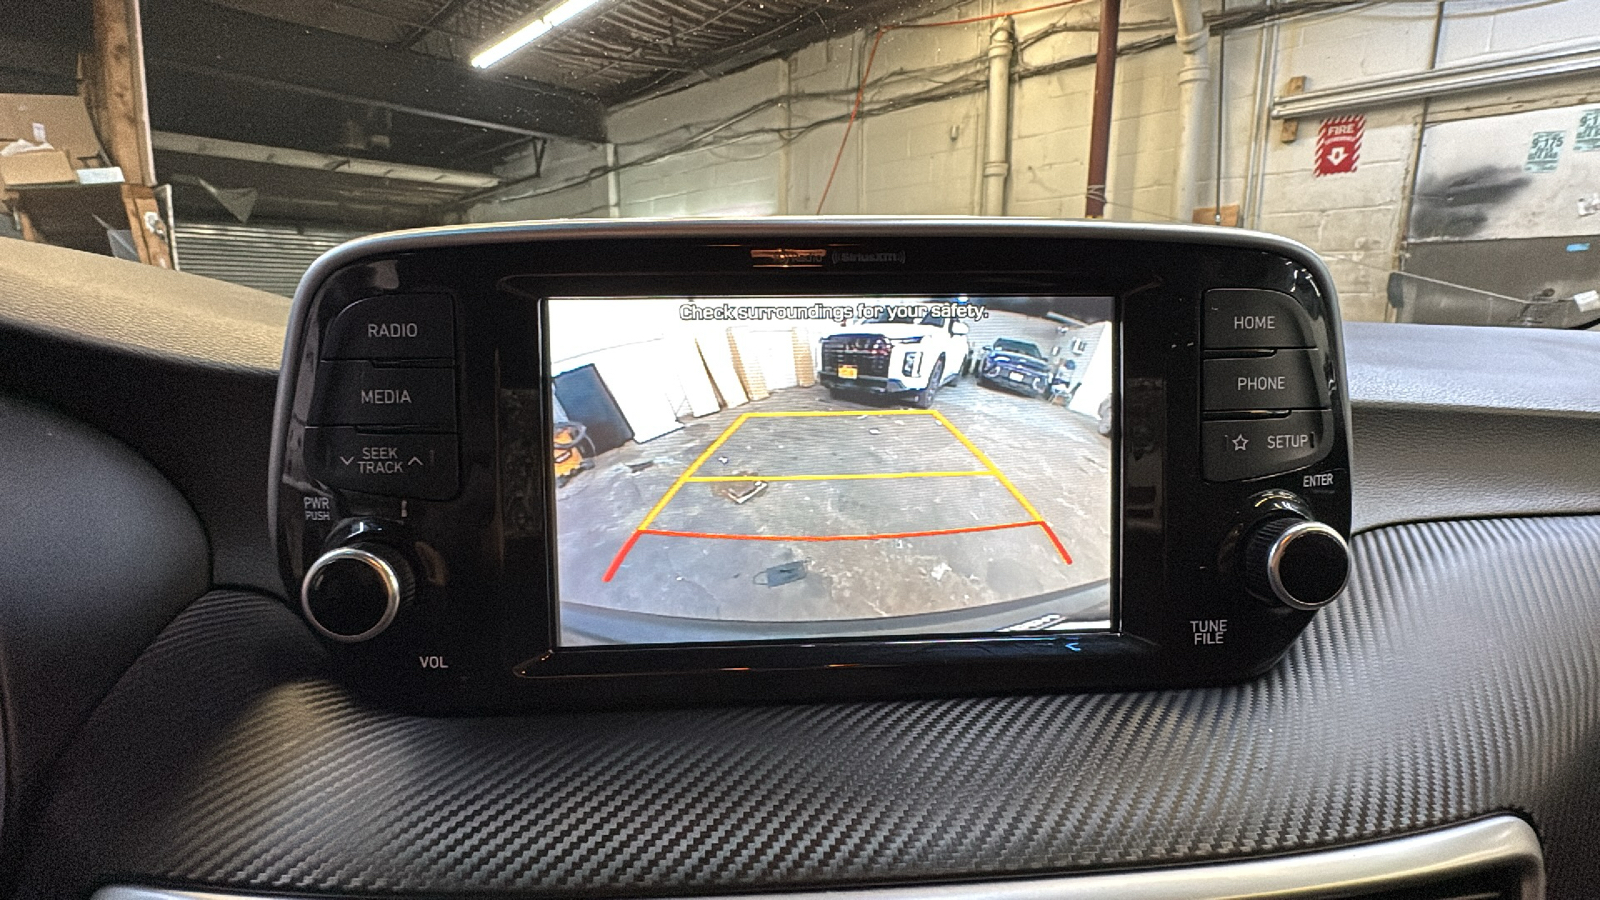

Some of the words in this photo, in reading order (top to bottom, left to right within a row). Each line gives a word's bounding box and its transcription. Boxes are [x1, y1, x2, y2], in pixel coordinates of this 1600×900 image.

[1327, 123, 1355, 136] FIRE
[679, 303, 737, 321] Check
[736, 303, 853, 323] surroundings
[857, 303, 884, 319] for
[885, 304, 927, 321] your
[931, 302, 989, 322] safety.
[1233, 315, 1276, 330] HOME
[367, 322, 418, 339] RADIO
[1237, 376, 1286, 391] PHONE
[360, 389, 412, 405] MEDIA
[1266, 434, 1309, 450] SETUP
[361, 447, 399, 461] SEEK
[357, 460, 404, 475] TRACK
[1302, 473, 1334, 488] ENTER
[303, 496, 331, 510] PWR
[304, 510, 331, 522] PUSH
[1190, 619, 1228, 633] TUNE
[1194, 632, 1224, 645] FILE
[419, 656, 449, 669] VOL
